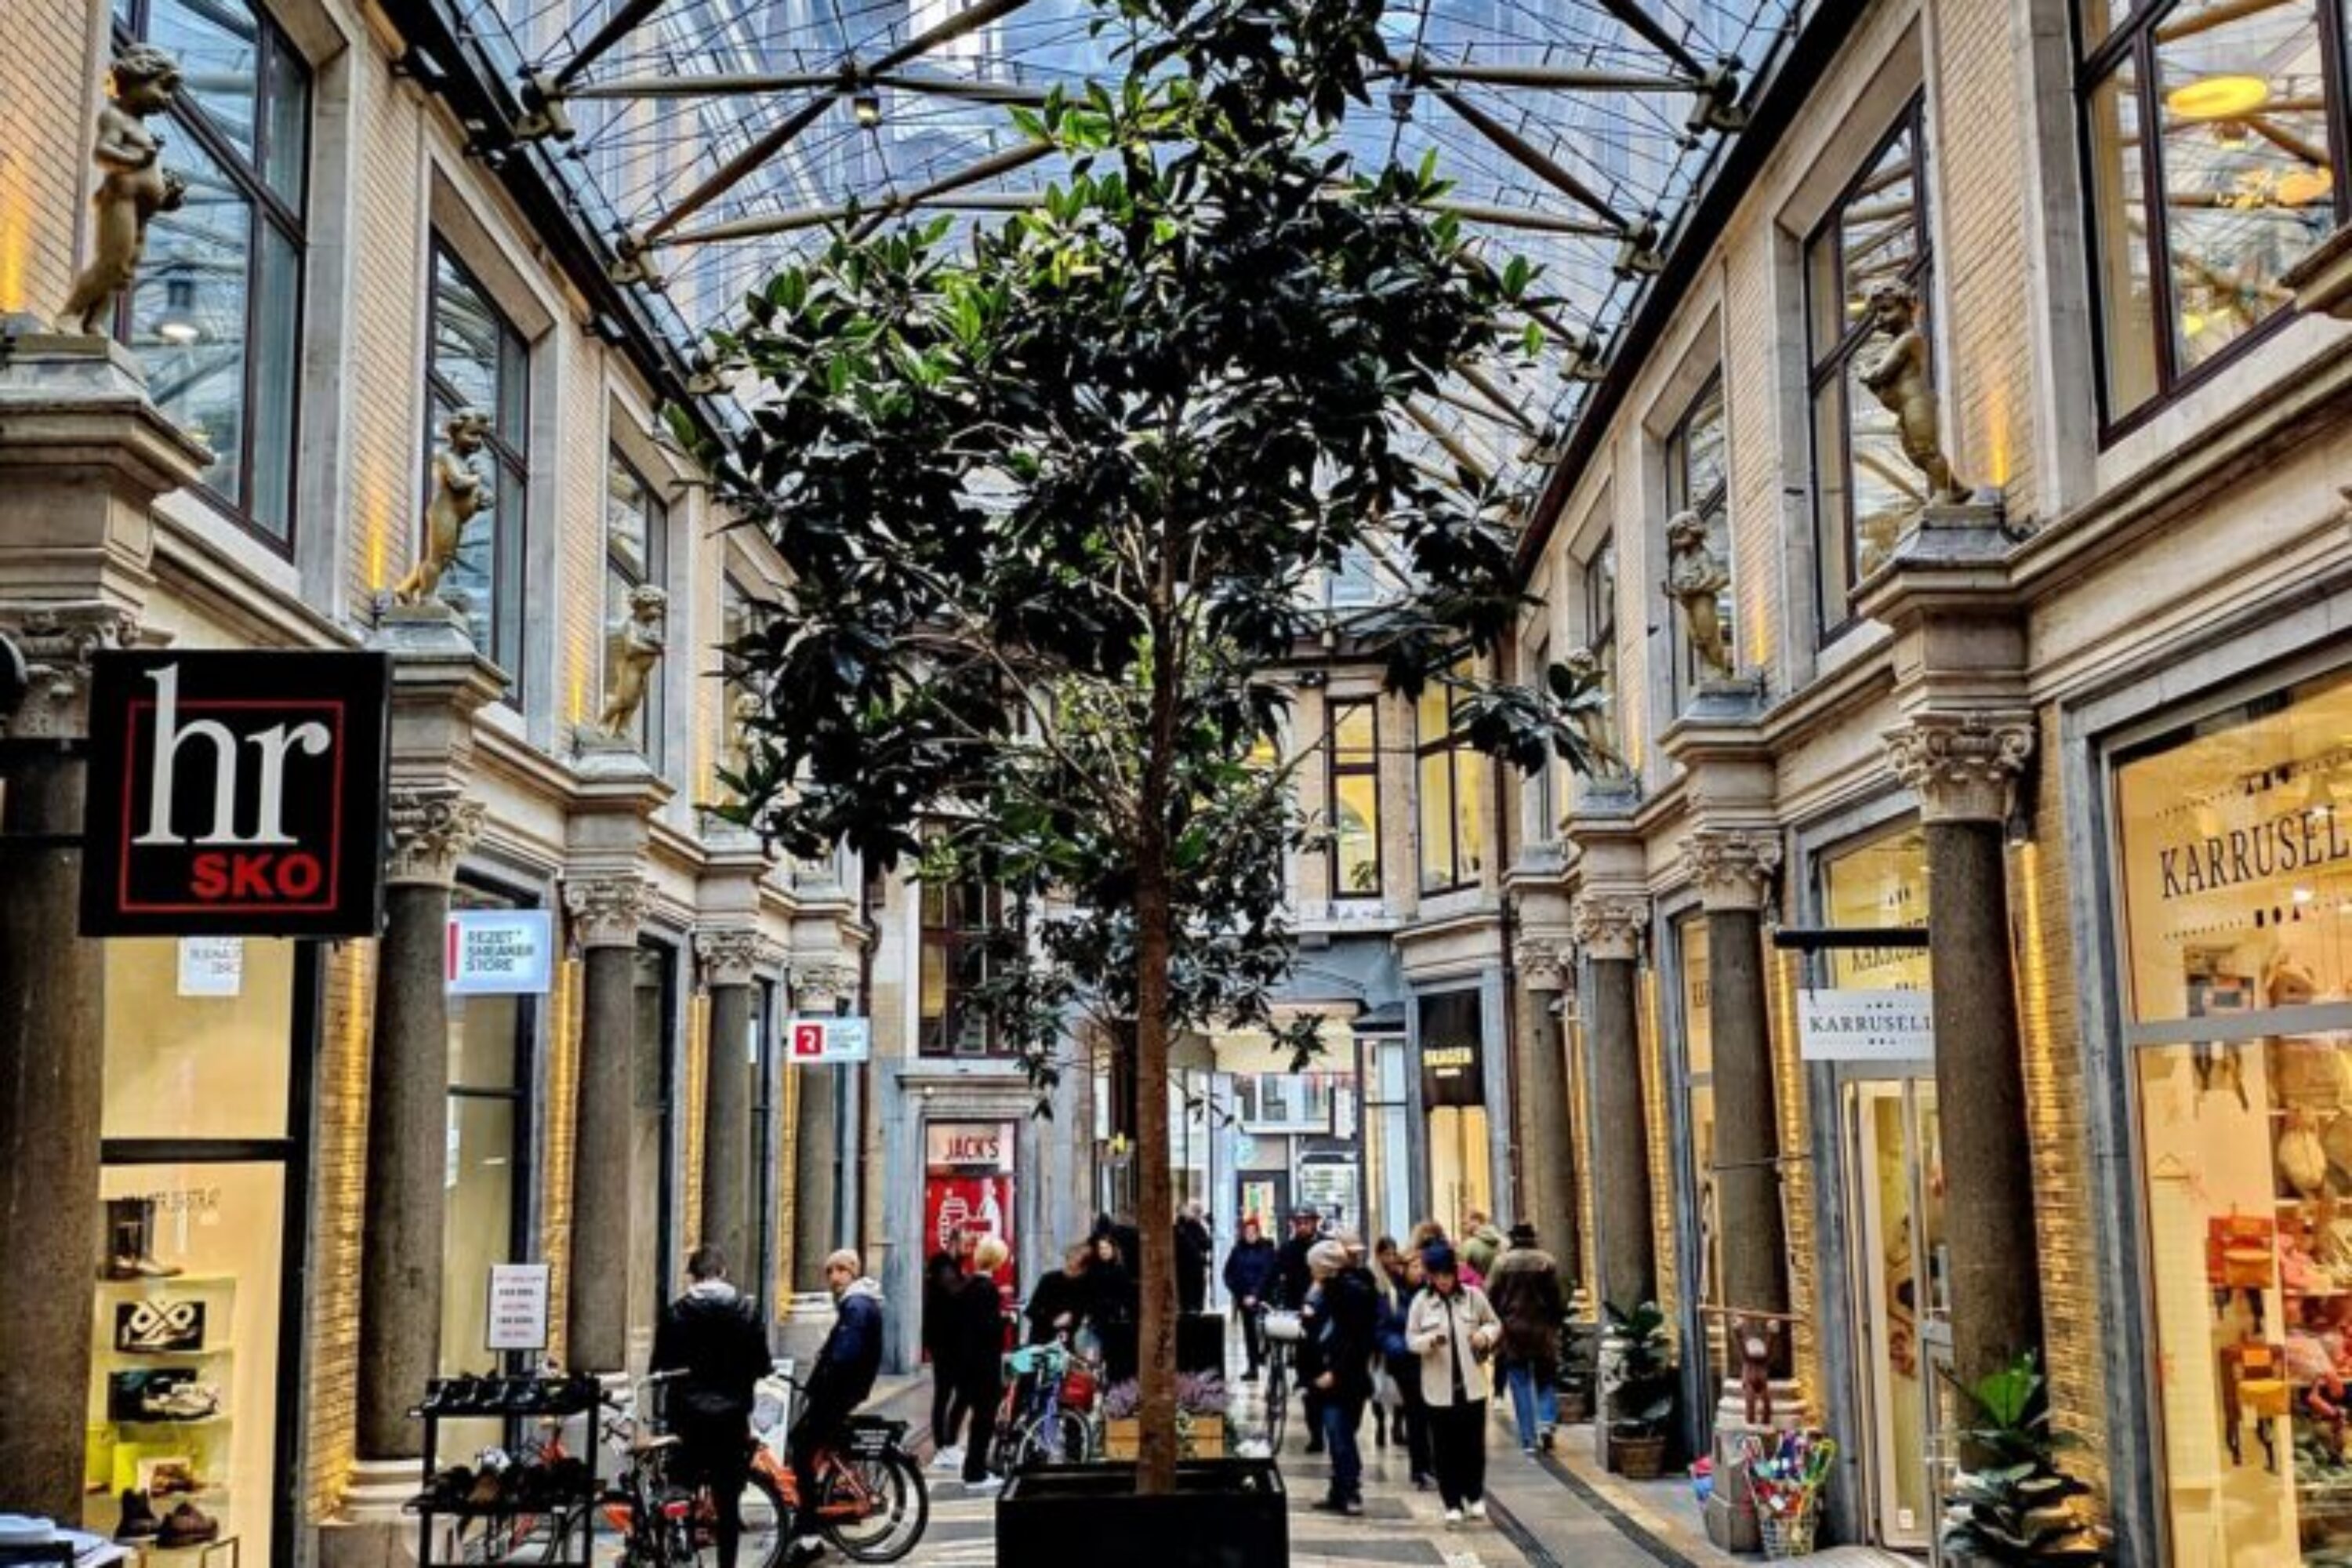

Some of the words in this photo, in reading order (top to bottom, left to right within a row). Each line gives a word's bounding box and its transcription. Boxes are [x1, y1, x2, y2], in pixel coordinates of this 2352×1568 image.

[132, 662, 332, 846] hr
[2159, 804, 2350, 899] KARRUSEL
[190, 853, 322, 898] SKO
[466, 958, 513, 971] STORE
[945, 1136, 999, 1160] JACK'S
